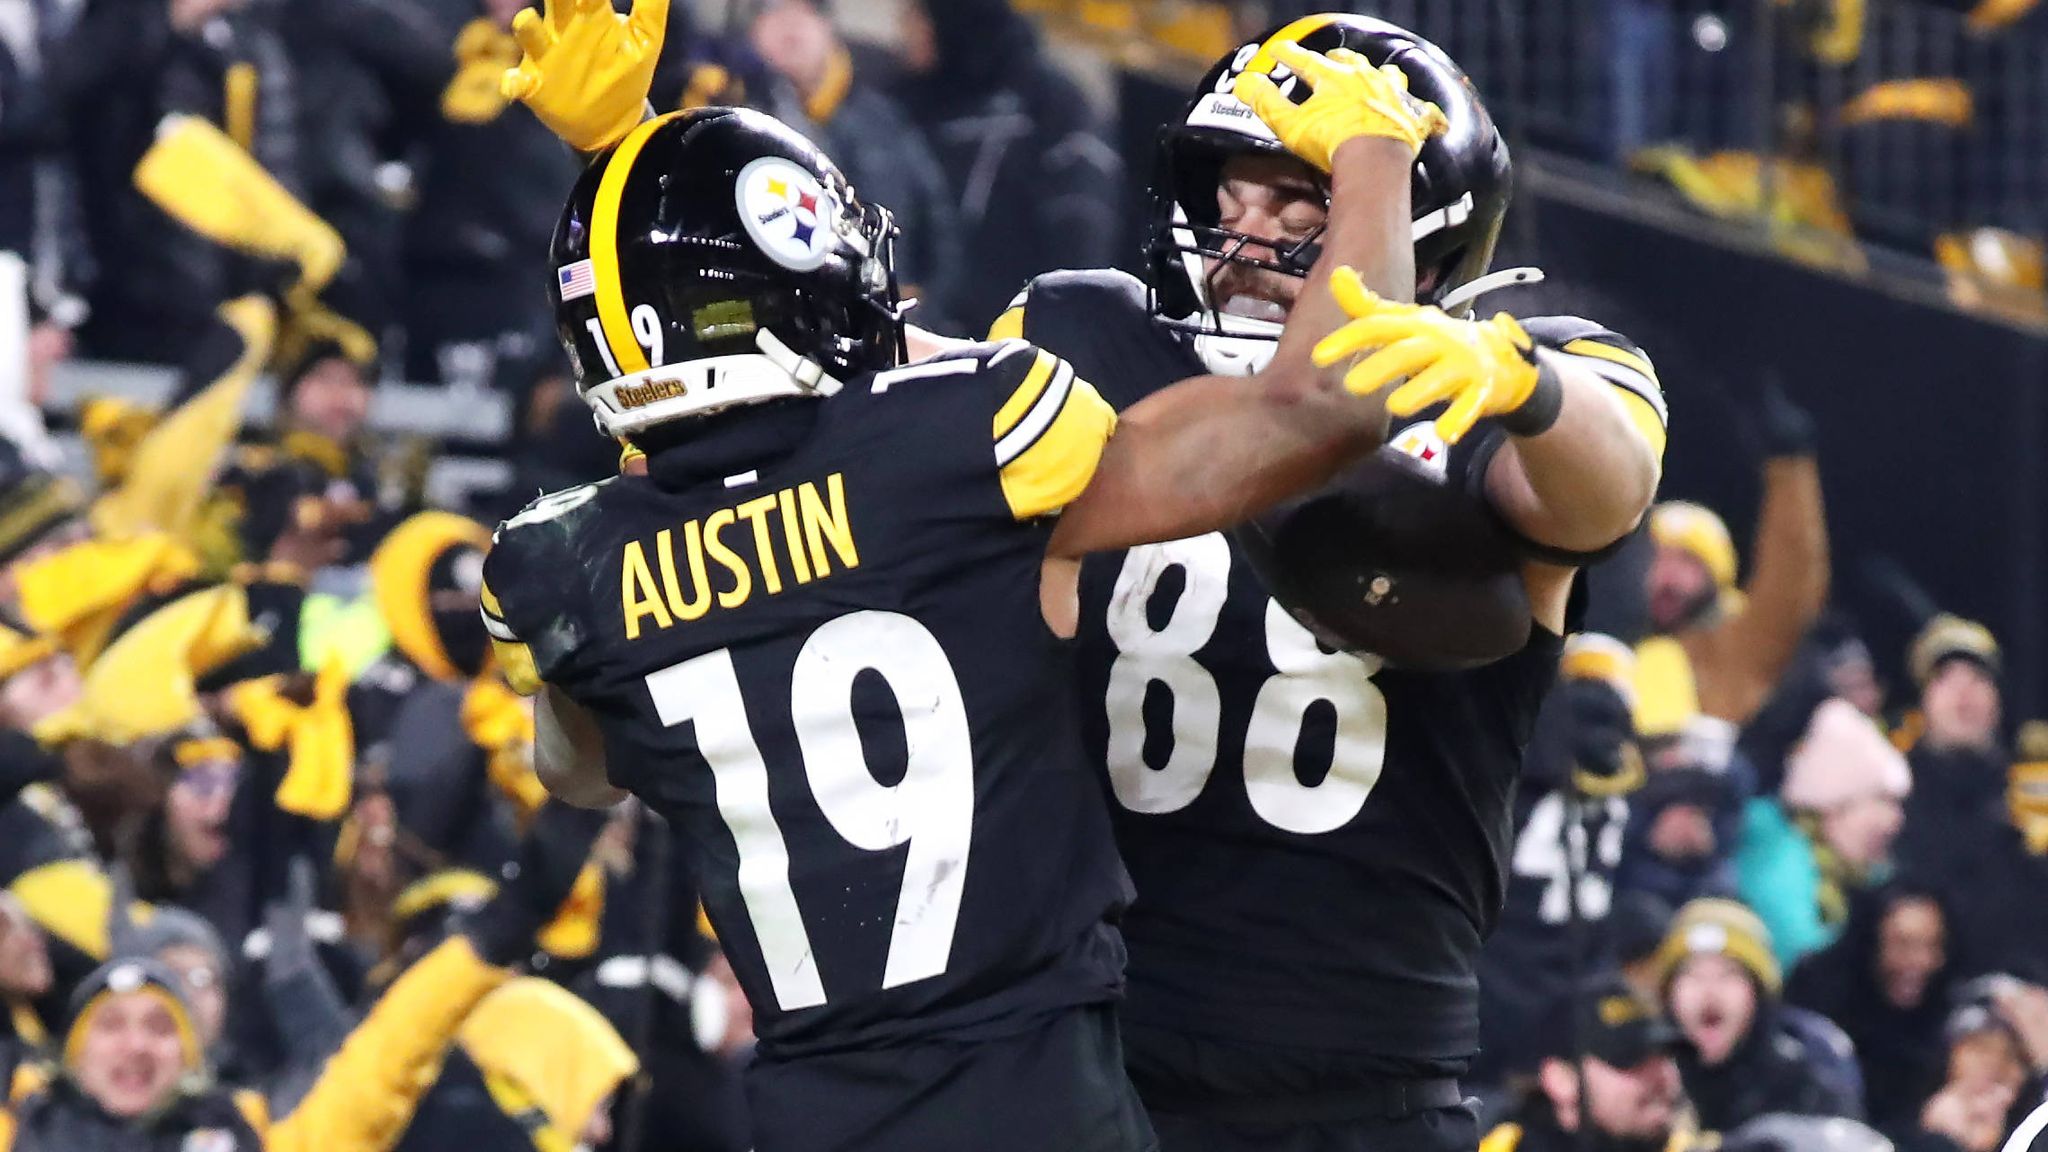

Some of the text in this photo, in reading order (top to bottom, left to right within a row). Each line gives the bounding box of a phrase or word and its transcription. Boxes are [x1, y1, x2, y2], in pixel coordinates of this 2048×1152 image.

[585, 303, 664, 378] 19
[614, 376, 688, 410] Steelers
[622, 472, 860, 640] AUSTIN
[1105, 531, 1388, 834] 88
[644, 609, 975, 1012] 19
